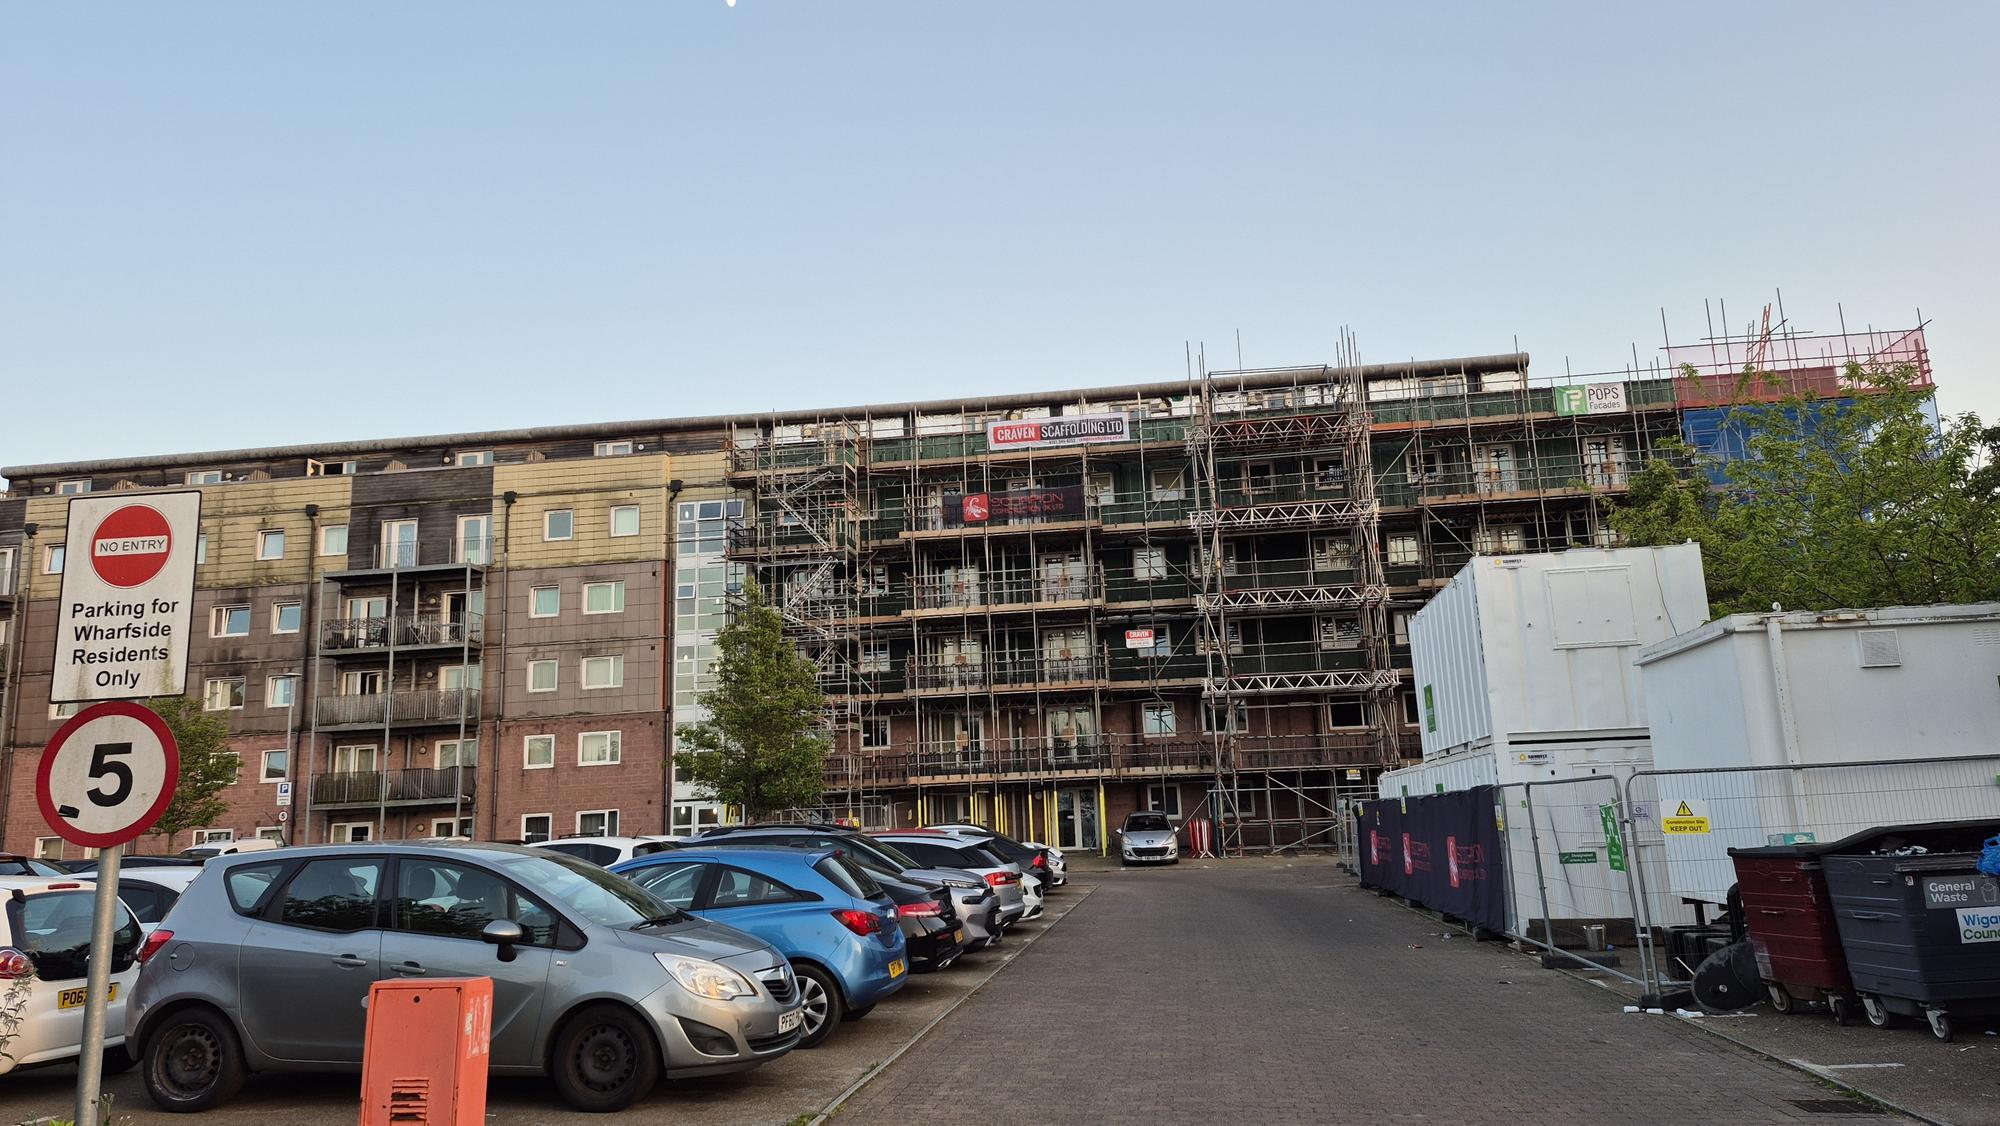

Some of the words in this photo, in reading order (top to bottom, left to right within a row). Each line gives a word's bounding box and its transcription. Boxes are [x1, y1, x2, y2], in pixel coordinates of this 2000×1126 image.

[1587, 387, 1619, 400] POPS
[1590, 401, 1620, 410] Facades
[997, 427, 1035, 441] CRAVEN
[1041, 421, 1105, 437] SCAFFOLDING
[1106, 420, 1123, 433] LTD
[99, 541, 119, 553] NO
[122, 539, 166, 551] ENTRY
[72, 601, 145, 619] Parking
[152, 598, 179, 614] for
[74, 622, 172, 642] Wharfside
[72, 646, 169, 665] Residents
[96, 669, 141, 689] Only
[86, 742, 133, 807] 5
[1929, 880, 1976, 892] General
[1930, 893, 1969, 903] Waste
[1962, 914, 2000, 928] Wiga
[62, 989, 88, 1006] PO6
